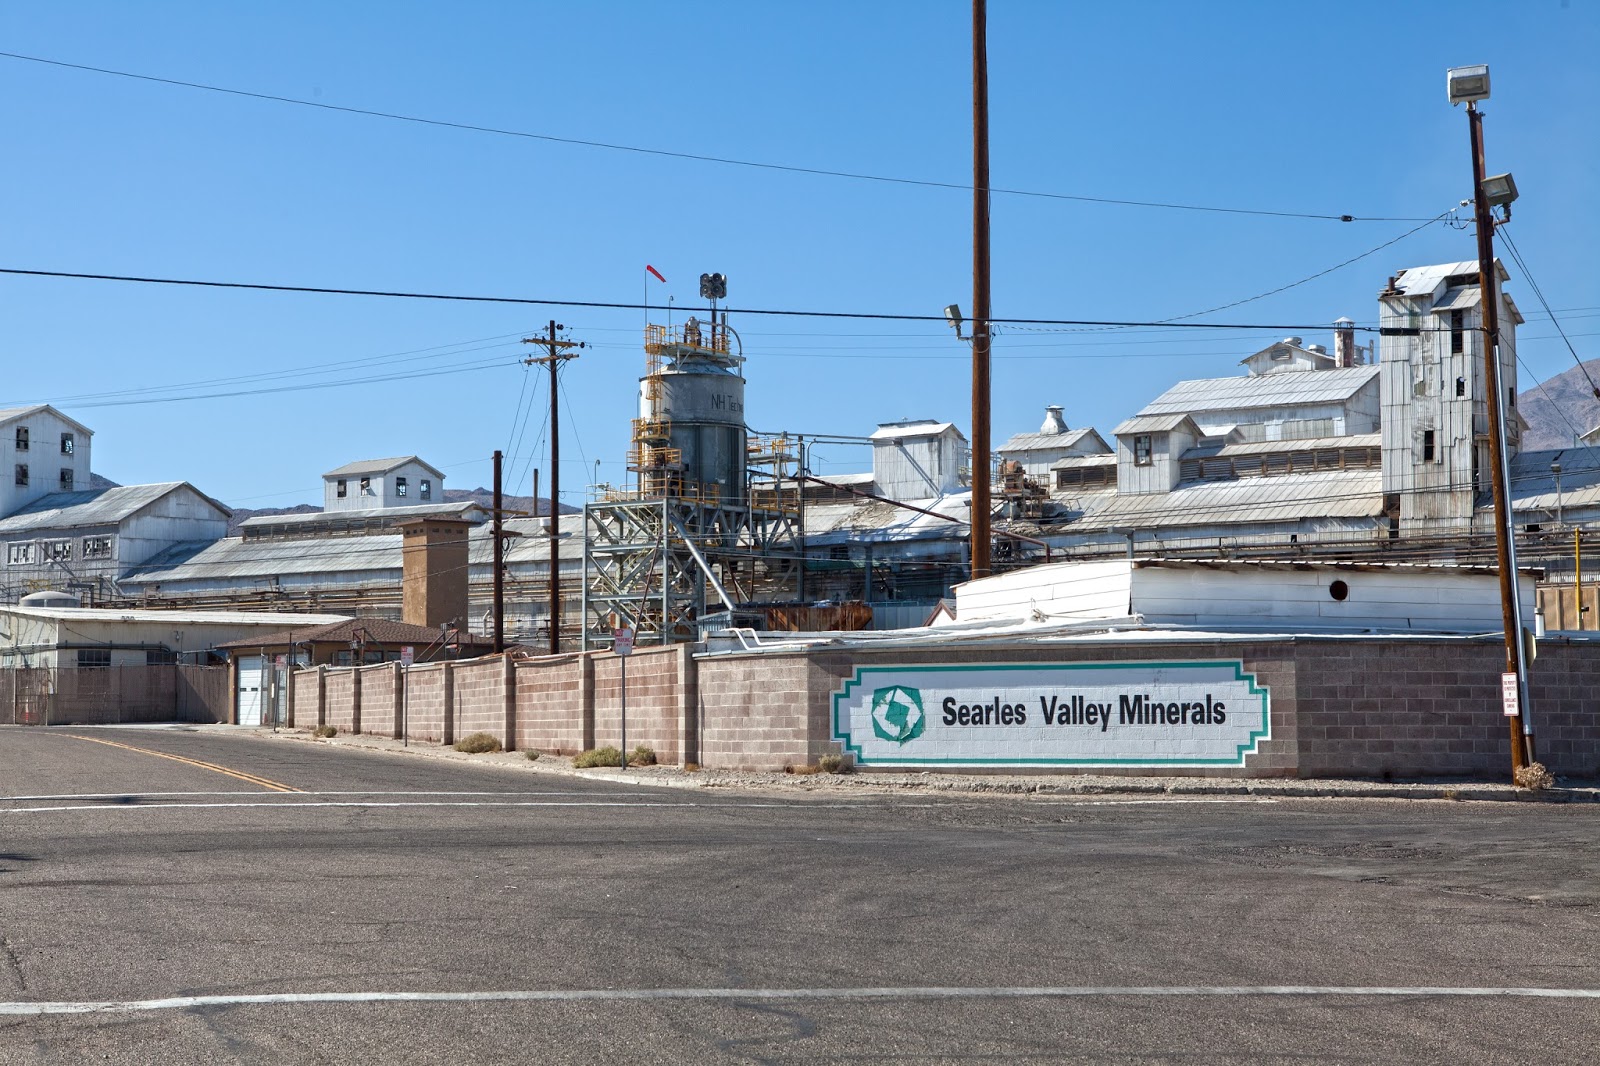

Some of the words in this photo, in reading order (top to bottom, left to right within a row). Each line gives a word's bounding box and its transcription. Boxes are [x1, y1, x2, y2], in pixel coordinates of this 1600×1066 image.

[711, 393, 725, 410] NH
[942, 696, 1026, 725] Searles
[1040, 695, 1112, 732] Valley
[1119, 694, 1226, 725] Minerals
